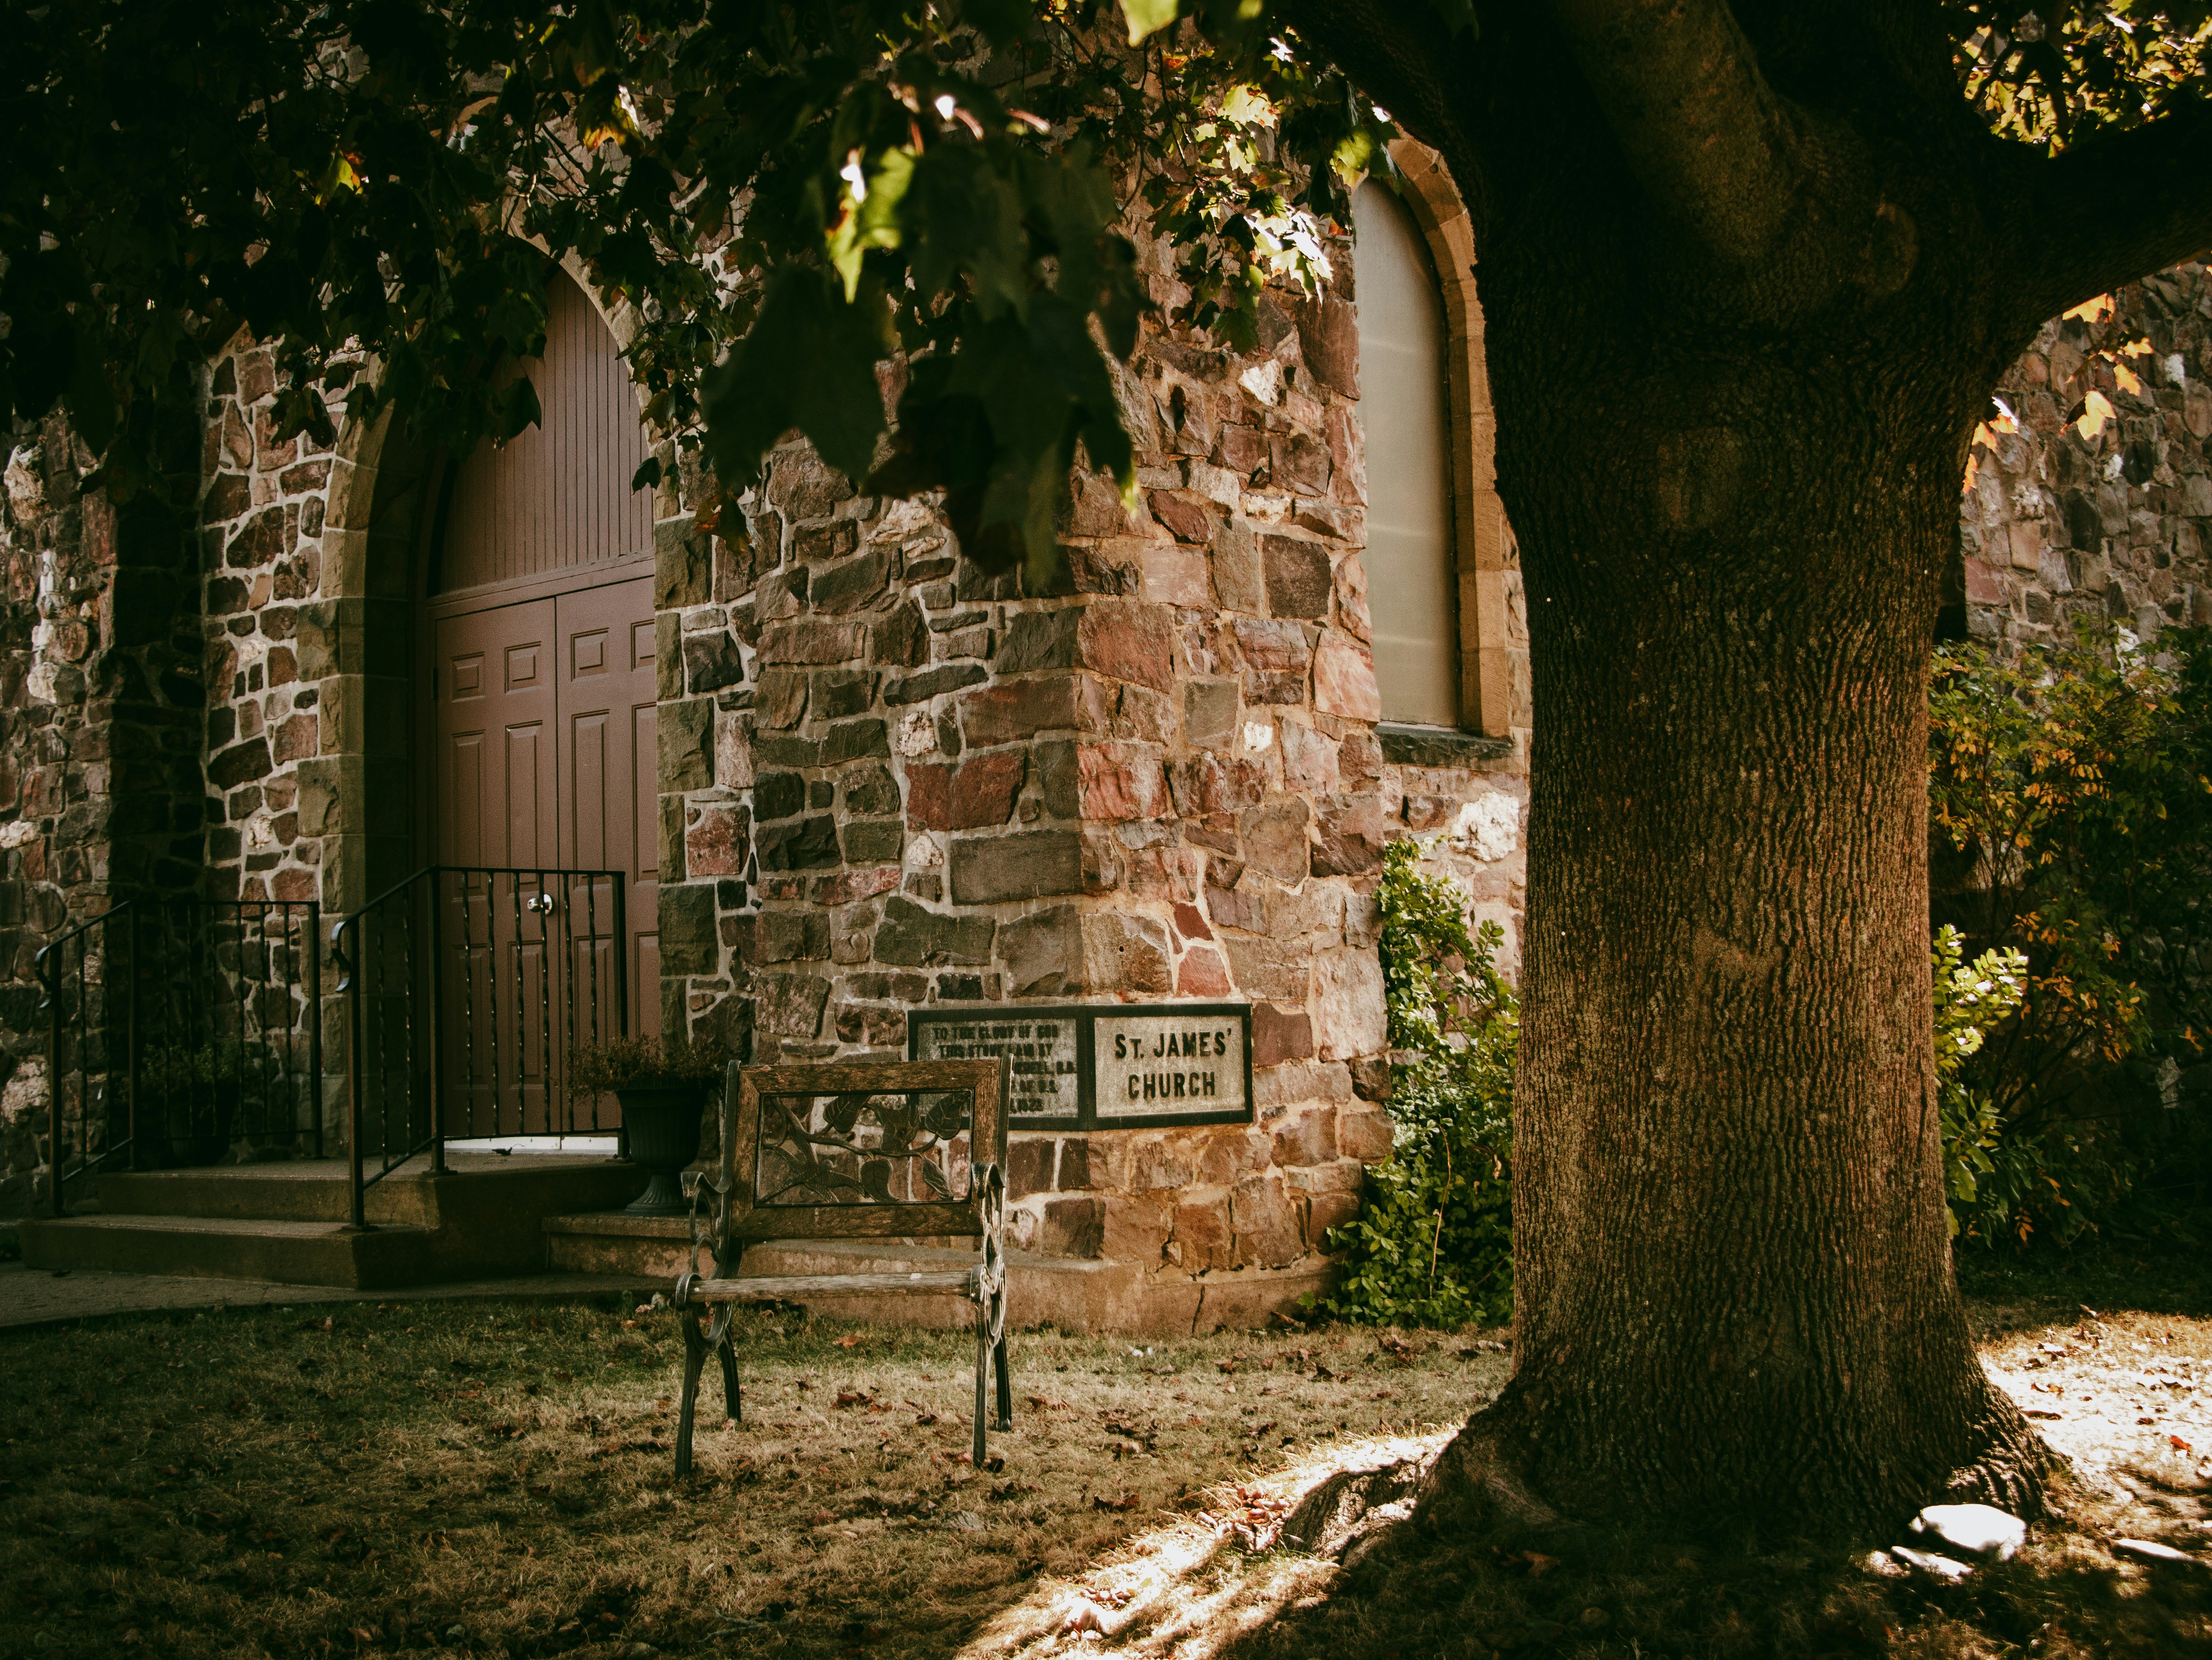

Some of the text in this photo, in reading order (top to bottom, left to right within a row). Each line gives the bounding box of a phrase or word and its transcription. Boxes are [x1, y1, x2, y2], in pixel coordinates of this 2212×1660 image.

[932, 1024, 1059, 1040] TO THE GLORY OF GOD
[1115, 1027, 1231, 1059] ST. JAMES'
[938, 1044, 964, 1058] THIS
[968, 1043, 1004, 1057] STONE
[1038, 1043, 1053, 1056] BY
[1128, 1071, 1215, 1099] CHURCH
